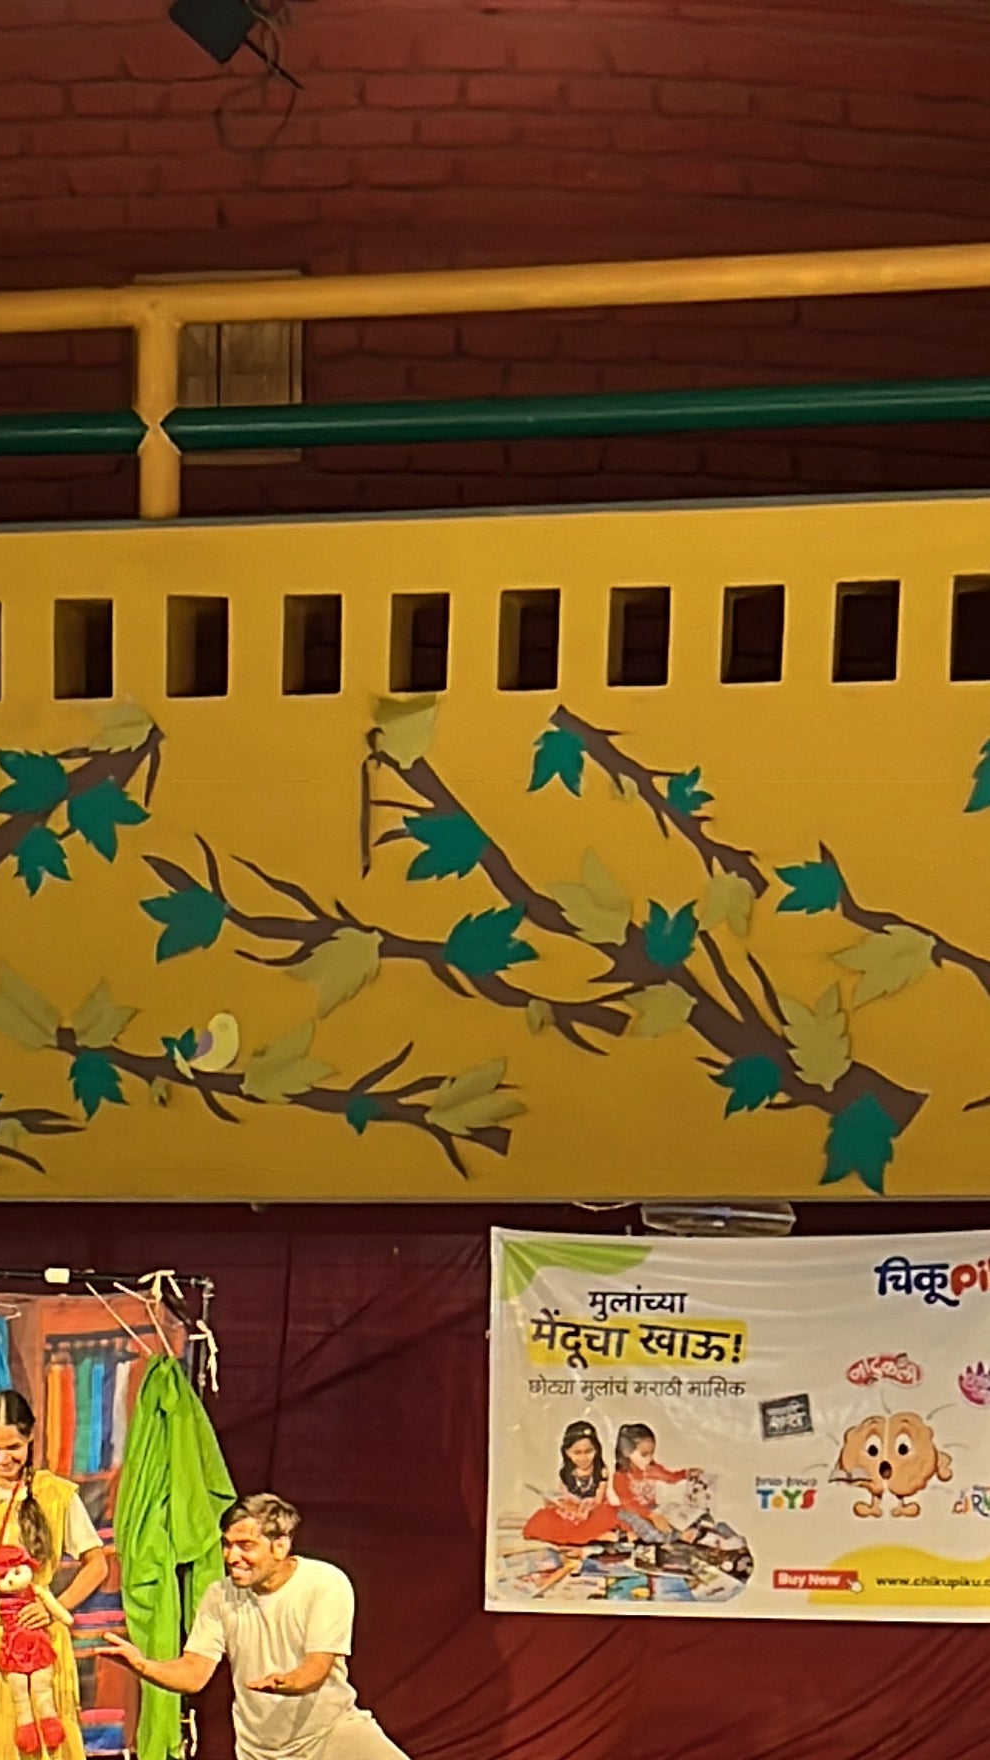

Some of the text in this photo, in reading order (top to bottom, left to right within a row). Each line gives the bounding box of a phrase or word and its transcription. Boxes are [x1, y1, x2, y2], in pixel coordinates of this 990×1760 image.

[874, 1256, 990, 1307] चिकूpi
[588, 1285, 688, 1321] मुलांच्या
[530, 1308, 743, 1369] मेंदूचा खाऊ!
[528, 1374, 575, 1396] छोट्या
[634, 1376, 683, 1397] मराठी
[687, 1376, 747, 1397] मासिक
[778, 1572, 841, 1588] Buy Now
